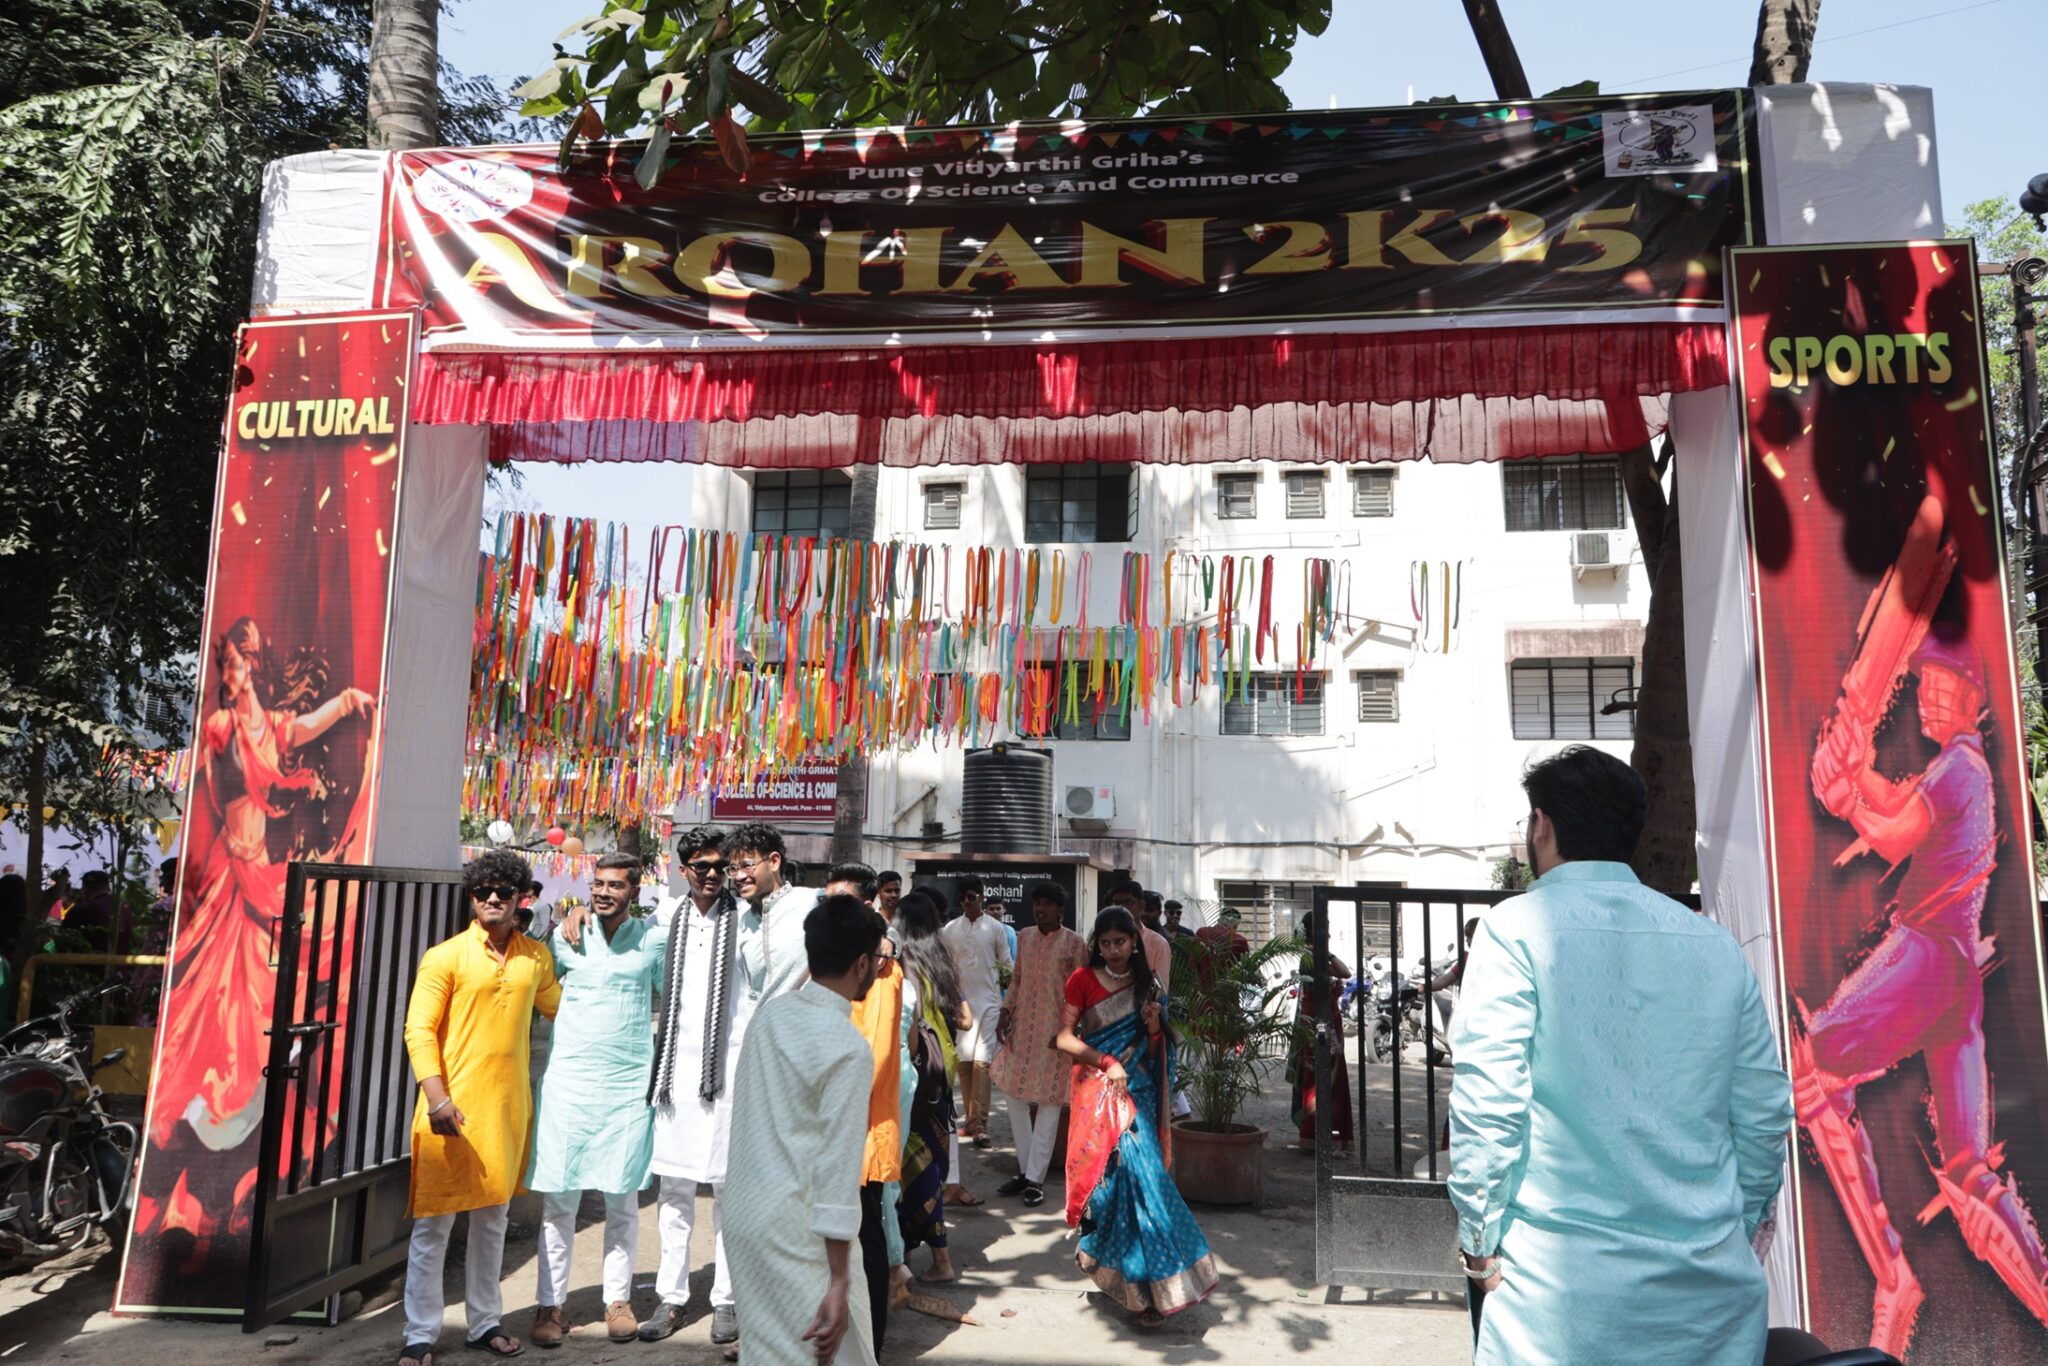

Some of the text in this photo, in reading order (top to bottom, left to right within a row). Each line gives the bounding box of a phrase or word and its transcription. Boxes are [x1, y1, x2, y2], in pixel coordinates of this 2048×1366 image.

[849, 150, 1204, 180] Pune Vidyarthi Griha's
[758, 171, 1299, 204] College Of Science And Commerce
[462, 202, 1643, 314] AROHAN 2K25
[1768, 332, 1952, 388] SPORTS
[238, 396, 395, 440] CULTURAL
[718, 782, 756, 799] OLLEGE
[756, 782, 768, 799] OF
[769, 782, 805, 799] SCIENCE
[806, 782, 813, 799] &
